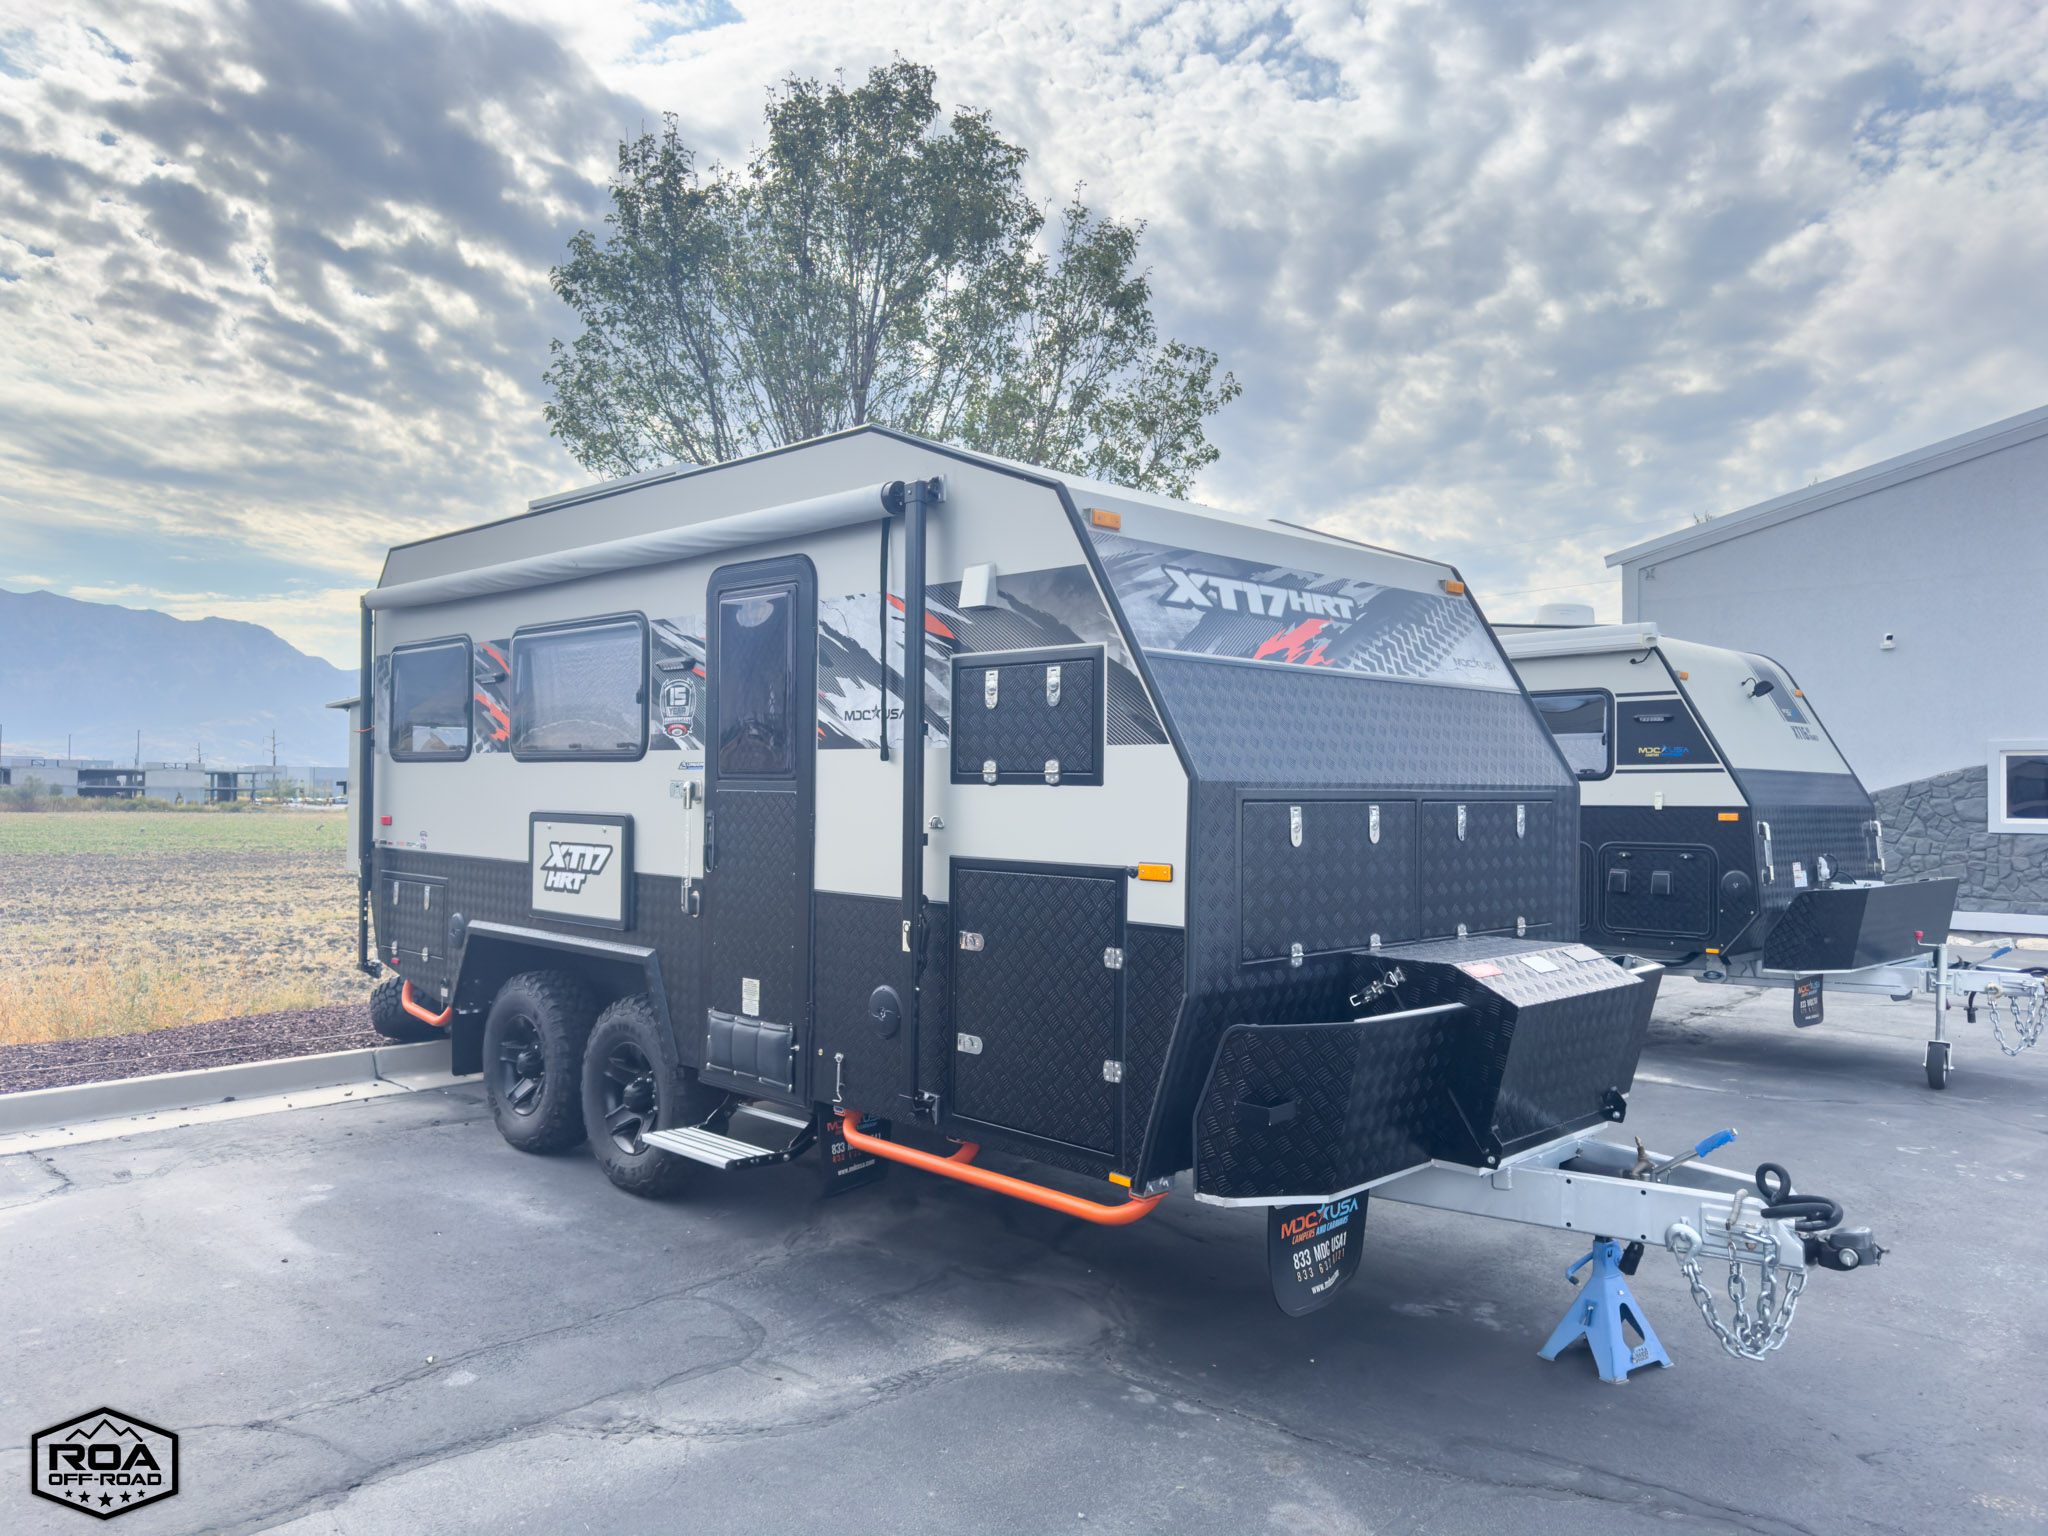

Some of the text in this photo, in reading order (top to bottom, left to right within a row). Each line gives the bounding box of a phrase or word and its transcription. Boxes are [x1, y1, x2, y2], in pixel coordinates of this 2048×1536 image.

[669, 686, 687, 706] 15
[844, 709, 872, 721] MDC
[542, 842, 613, 873] XT17
[544, 869, 587, 893] HRT
[831, 1142, 845, 1155] 833
[1281, 1197, 1359, 1240] MDC USA
[1291, 1228, 1316, 1246] CAMPERS
[1292, 1248, 1312, 1270] 833
[1313, 1240, 1331, 1262] MDC
[1296, 1266, 1315, 1282] 833
